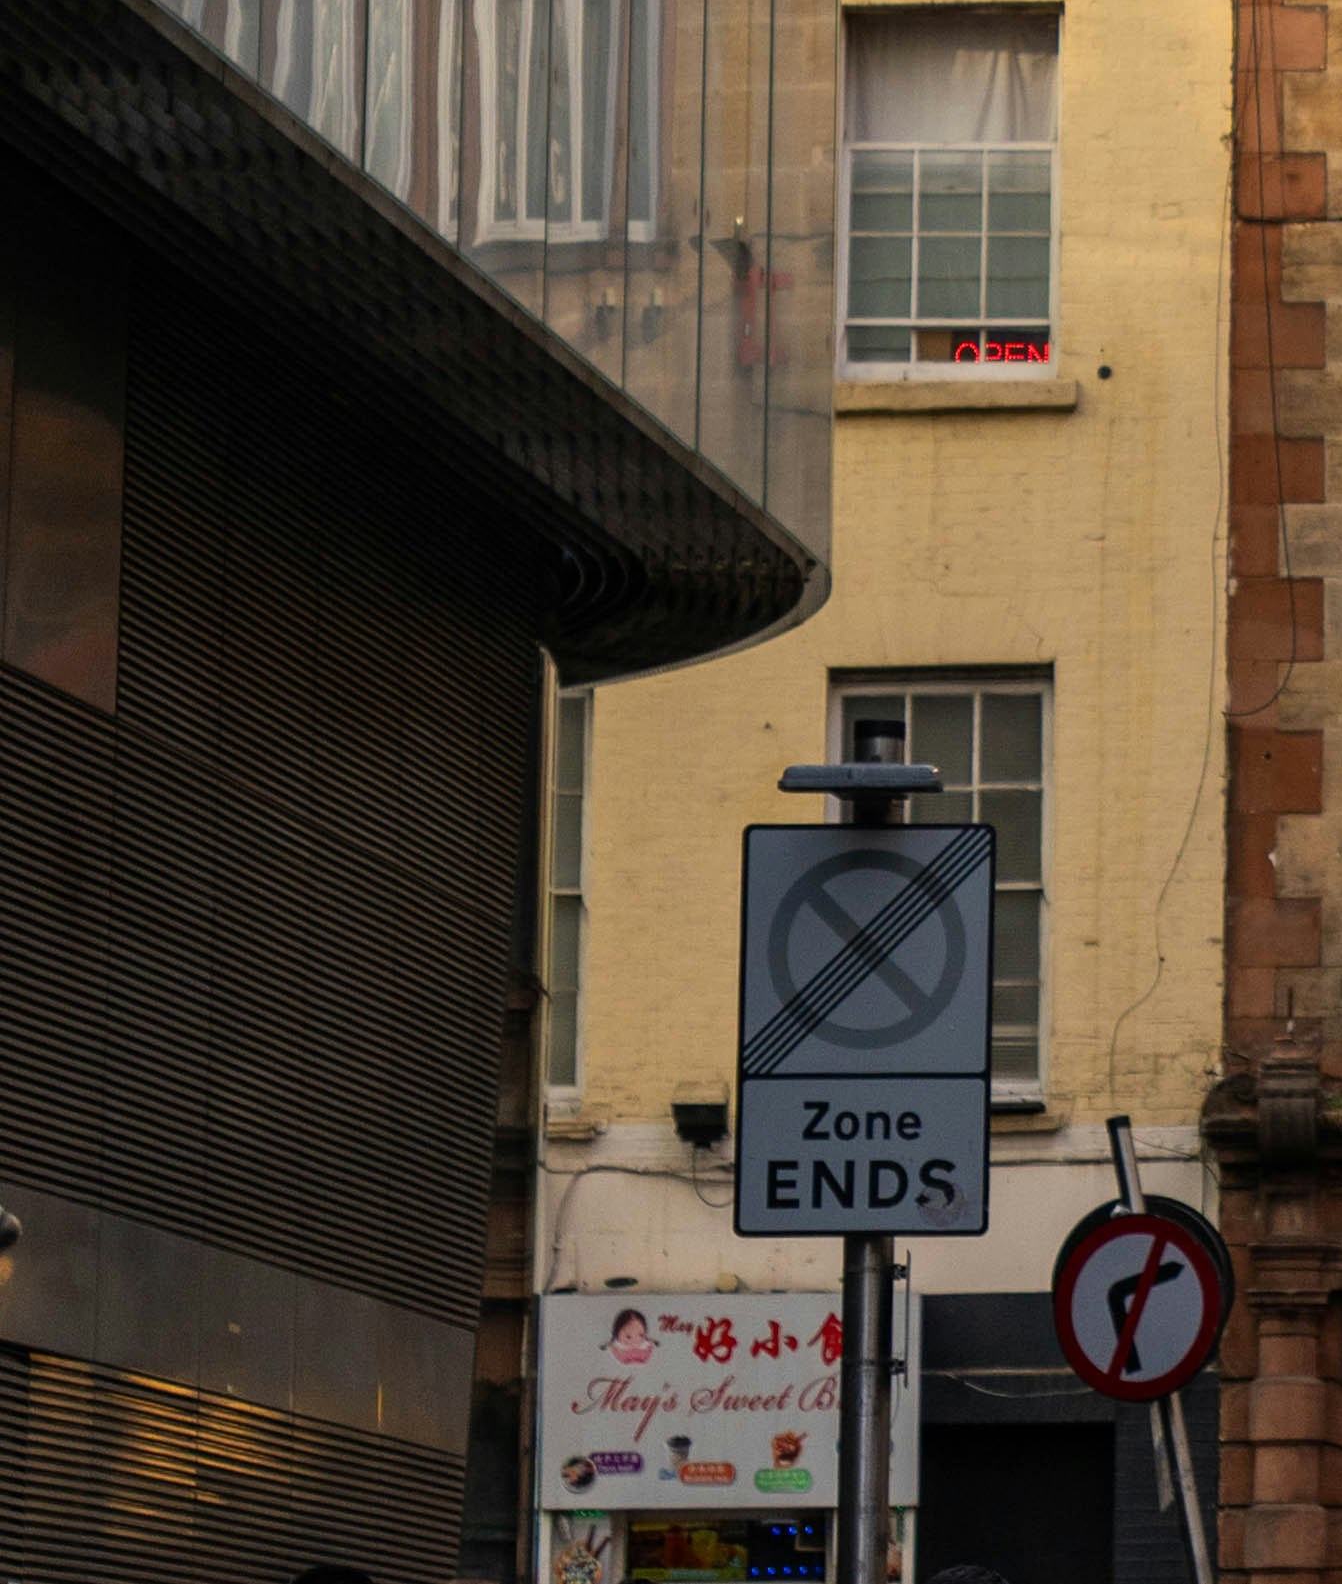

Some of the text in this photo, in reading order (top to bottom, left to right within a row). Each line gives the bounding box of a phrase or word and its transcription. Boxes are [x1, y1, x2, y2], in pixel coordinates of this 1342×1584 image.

[955, 342, 1050, 364] OPEN
[802, 1101, 922, 1141] Zone
[766, 1159, 956, 1209] ENDS
[571, 1374, 842, 1442] May's Sweet B
